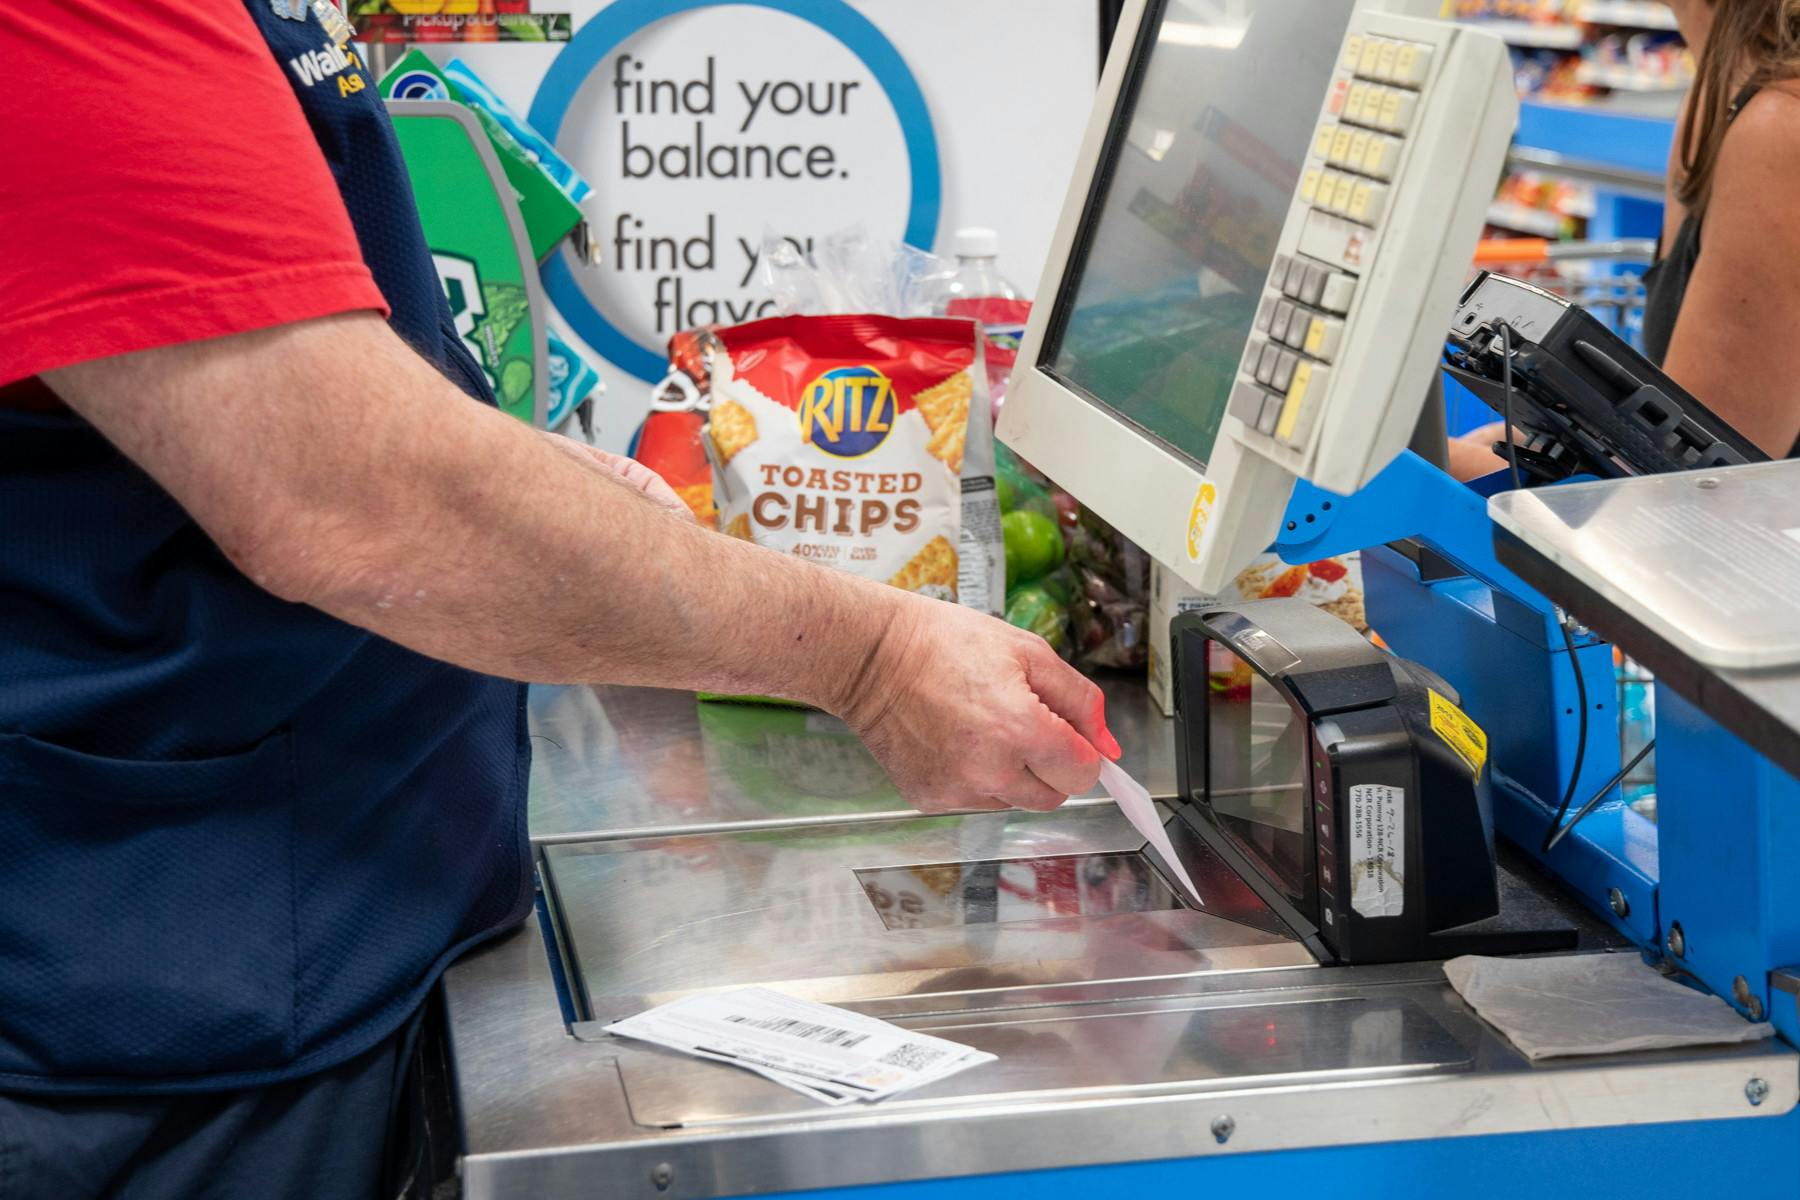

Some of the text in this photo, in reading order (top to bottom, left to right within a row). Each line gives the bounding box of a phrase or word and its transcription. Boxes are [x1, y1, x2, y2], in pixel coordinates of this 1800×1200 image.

[613, 54, 861, 133] find your
[621, 120, 849, 179] balance.
[613, 213, 715, 271] find
[801, 376, 892, 444] RITZ
[760, 463, 922, 494] TOASTED
[752, 491, 923, 538] CHIPS
[1365, 805, 1373, 848] Corporation
